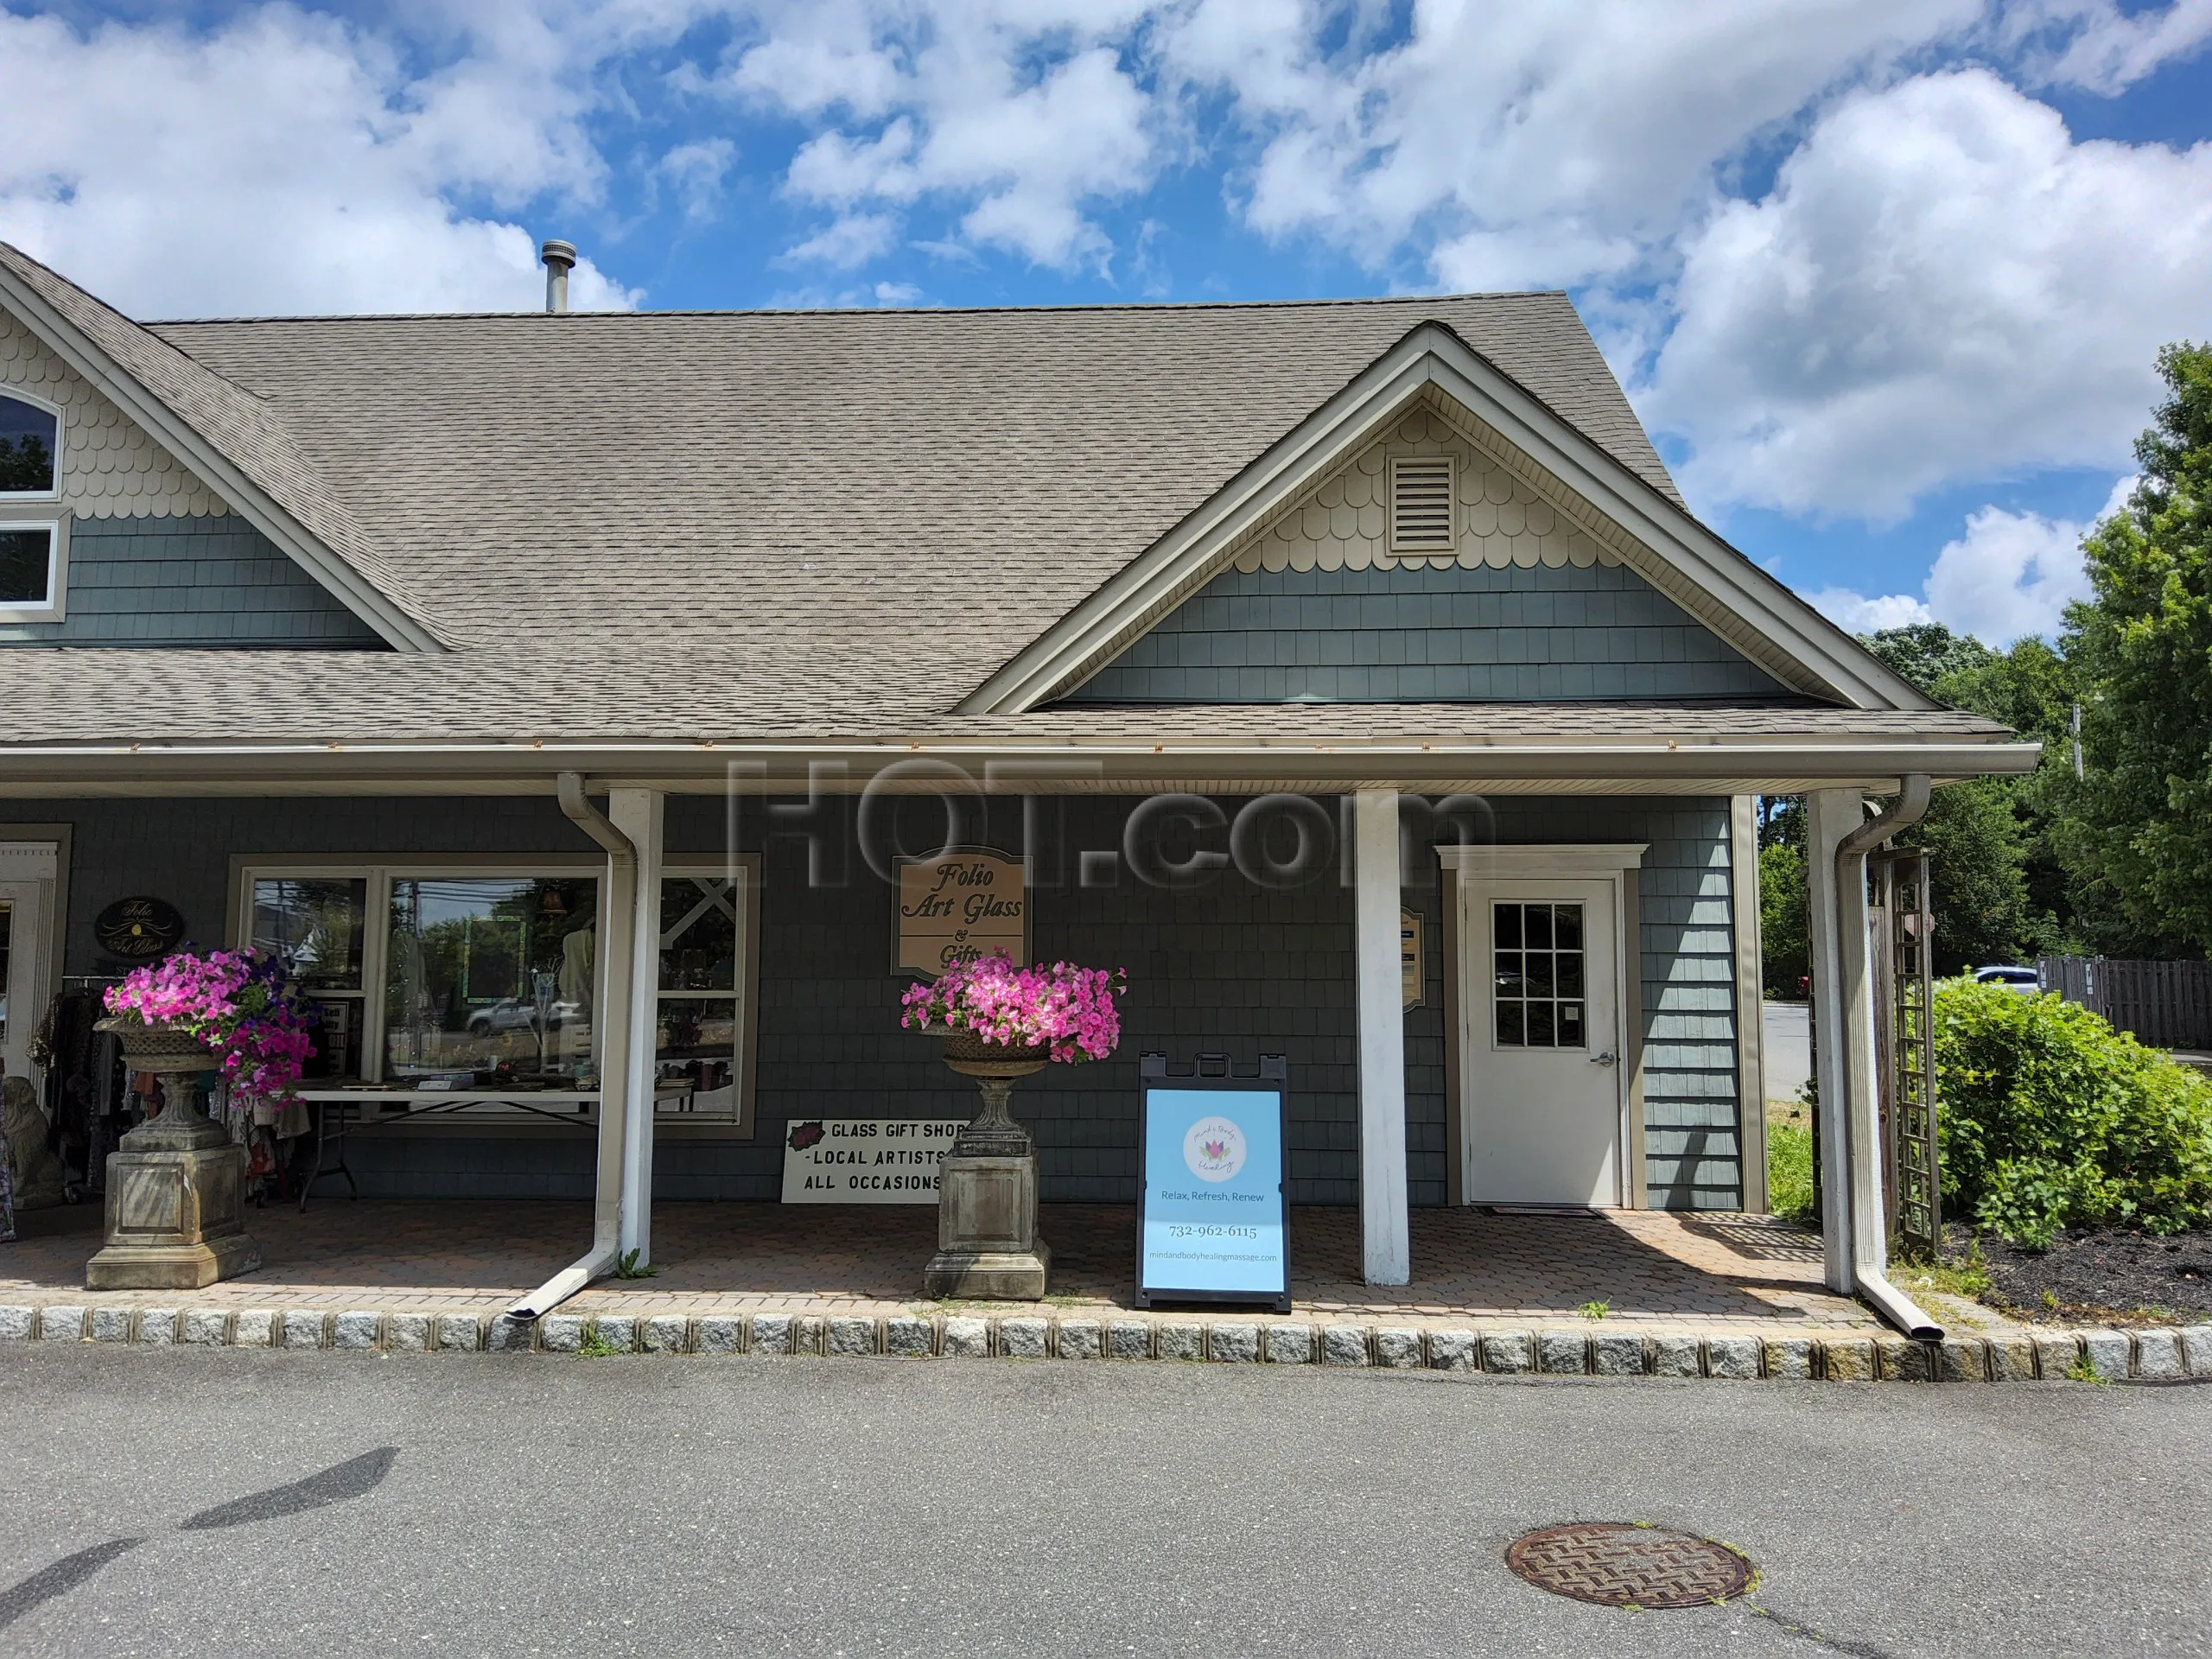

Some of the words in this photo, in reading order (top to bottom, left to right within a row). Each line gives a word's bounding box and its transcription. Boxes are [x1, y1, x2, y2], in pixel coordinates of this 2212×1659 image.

[931, 863, 994, 892] Folio
[901, 893, 955, 917] Art
[963, 893, 1022, 924] Glass
[954, 929, 968, 942] &
[940, 944, 982, 969] Gifts
[831, 1123, 878, 1137] GLASS
[886, 1123, 918, 1137] GIFT
[873, 1150, 945, 1166] ARTISTS
[1198, 1160, 1234, 1173] Healing
[804, 1175, 836, 1189] ALL
[849, 1175, 940, 1190] OCCASIONS
[1161, 1191, 1190, 1201] Relax,
[1192, 1192, 1230, 1202] Refresh,
[1232, 1192, 1264, 1202] Renew
[1168, 1225, 1257, 1239] 732-962-6115
[1149, 1251, 1277, 1262] mindandbodyhealingmassage.com
